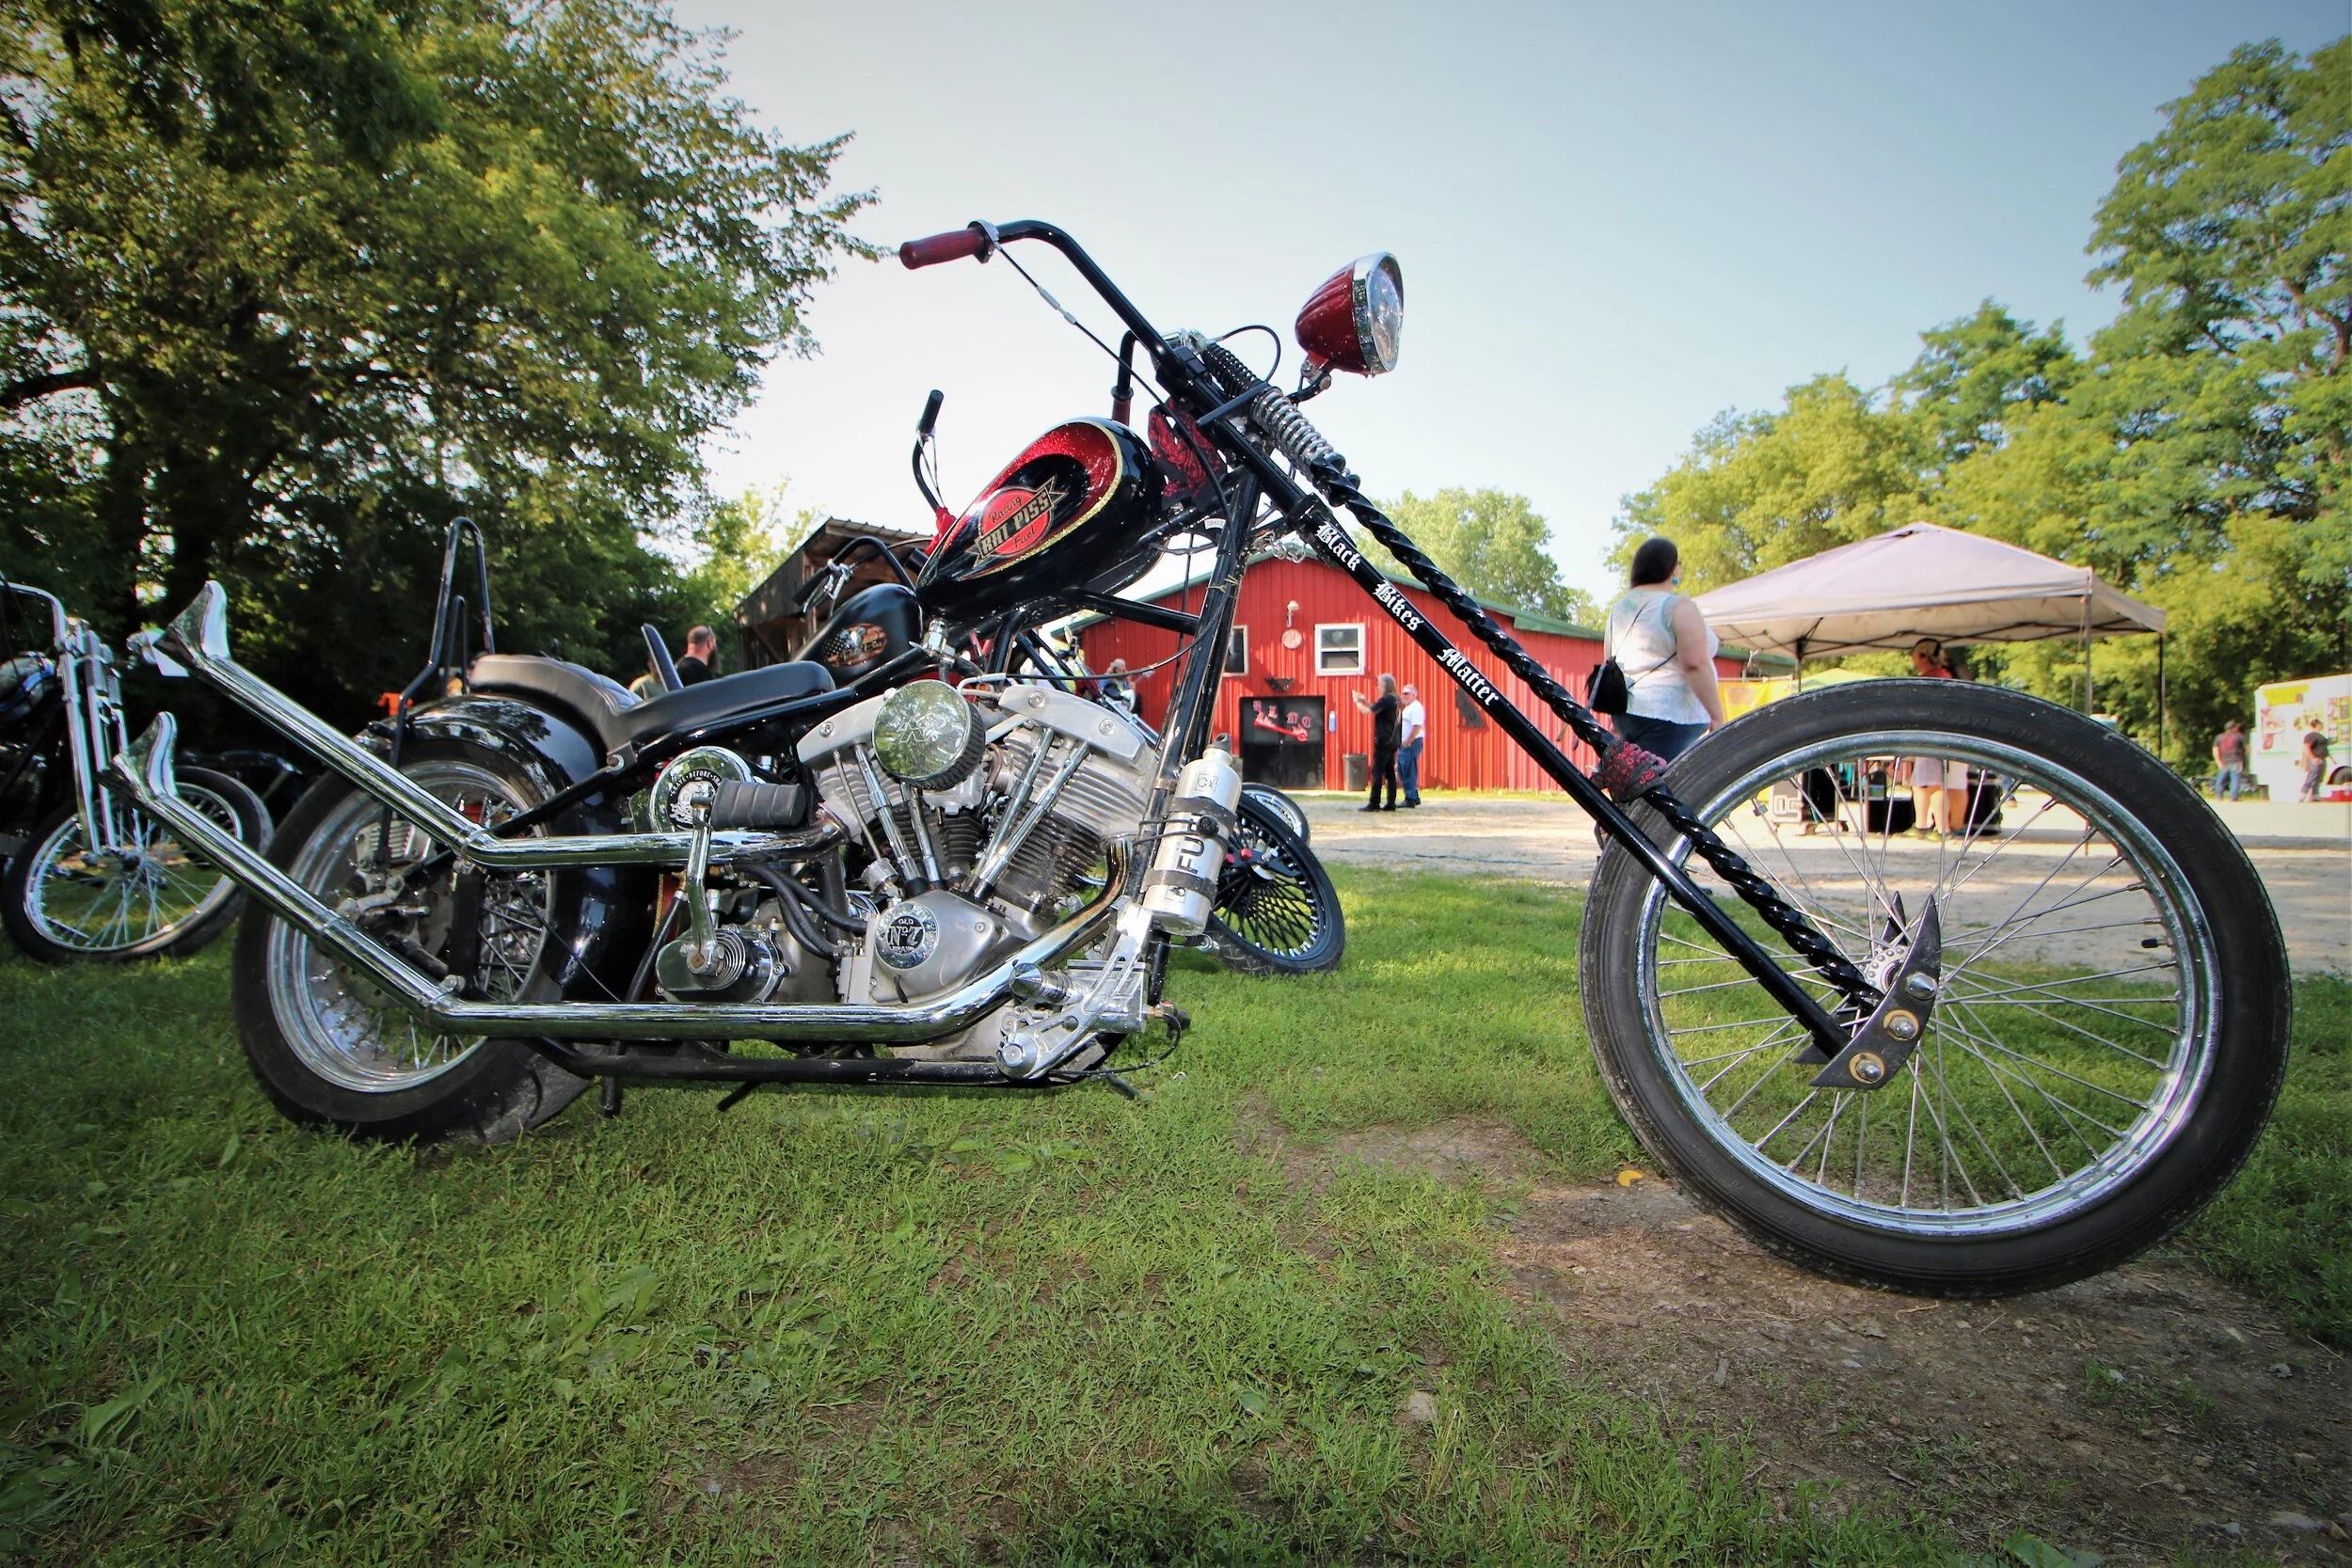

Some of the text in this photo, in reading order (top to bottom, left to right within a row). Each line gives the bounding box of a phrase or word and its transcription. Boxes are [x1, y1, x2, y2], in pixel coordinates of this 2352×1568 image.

[988, 496, 1023, 523] Racing
[1011, 491, 1051, 531] PISS
[1014, 524, 1036, 548] Fuel
[1314, 521, 1499, 706] Black Bikes Matter
[672, 770, 710, 795] GRAVE BEFORE
